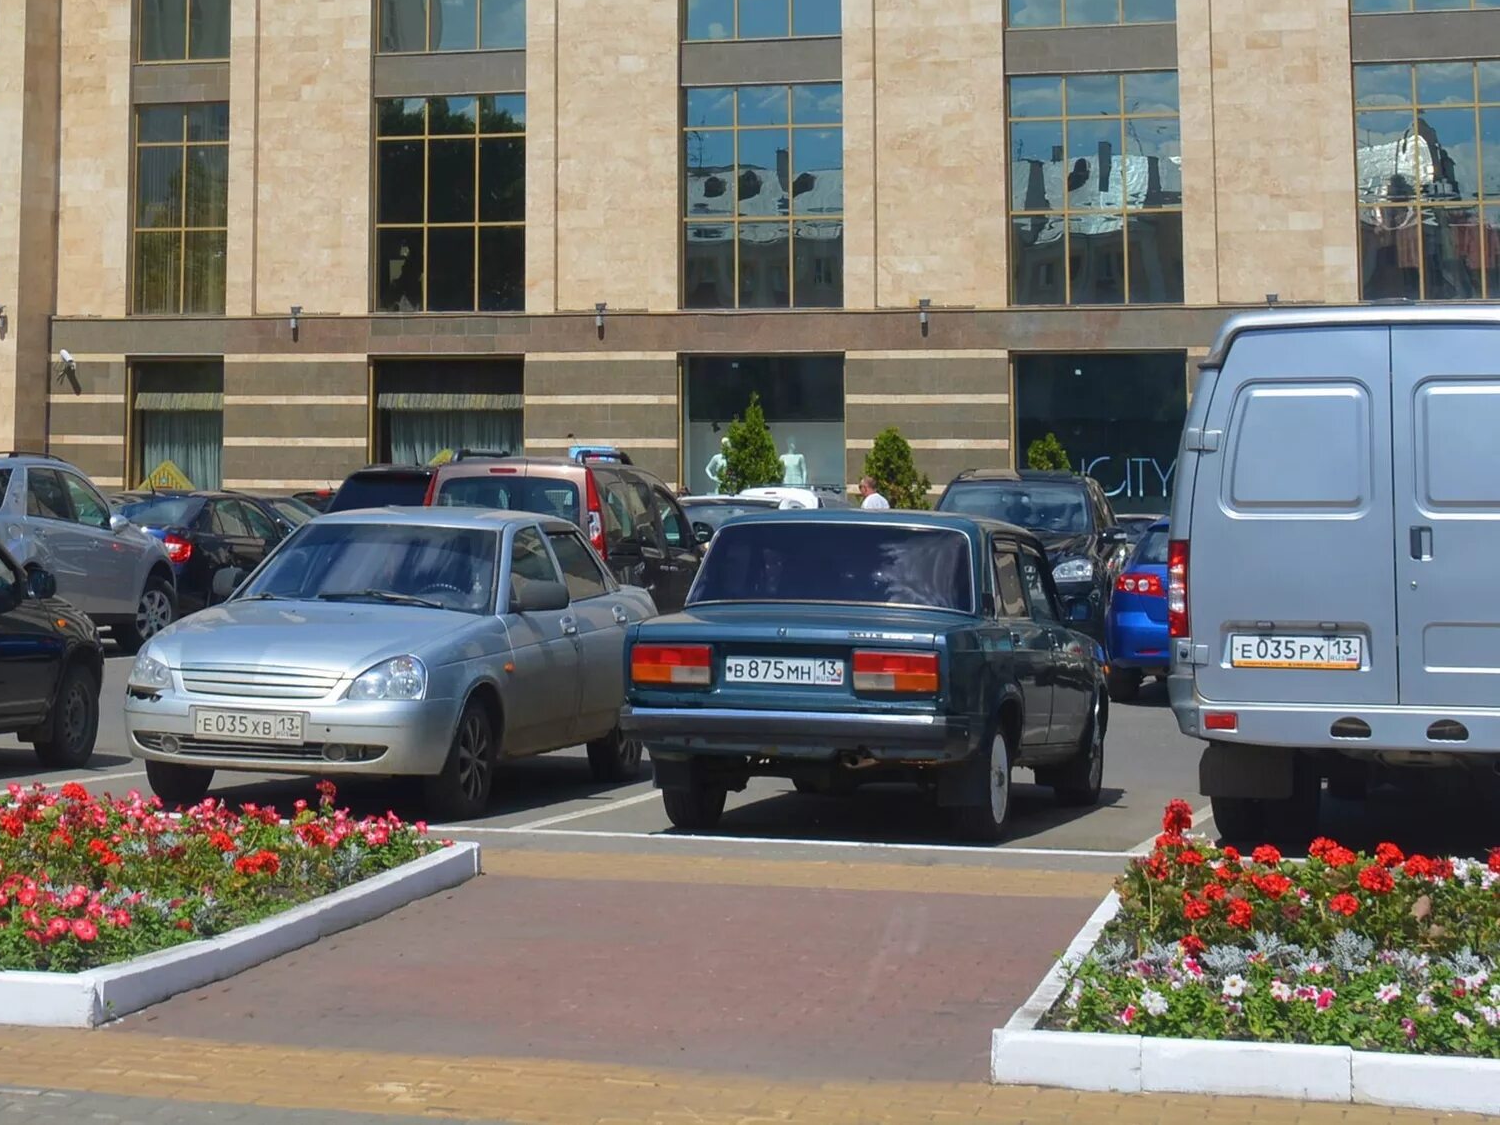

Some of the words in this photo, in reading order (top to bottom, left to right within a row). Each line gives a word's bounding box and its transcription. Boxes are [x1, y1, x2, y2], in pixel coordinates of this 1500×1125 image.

[1241, 639, 1325, 661] Е035РХ
[1332, 639, 1352, 655] 13
[733, 660, 812, 681] В875МН
[818, 660, 836, 676] 13
[203, 715, 272, 736] Е035ХВ
[278, 717, 295, 731] 13
